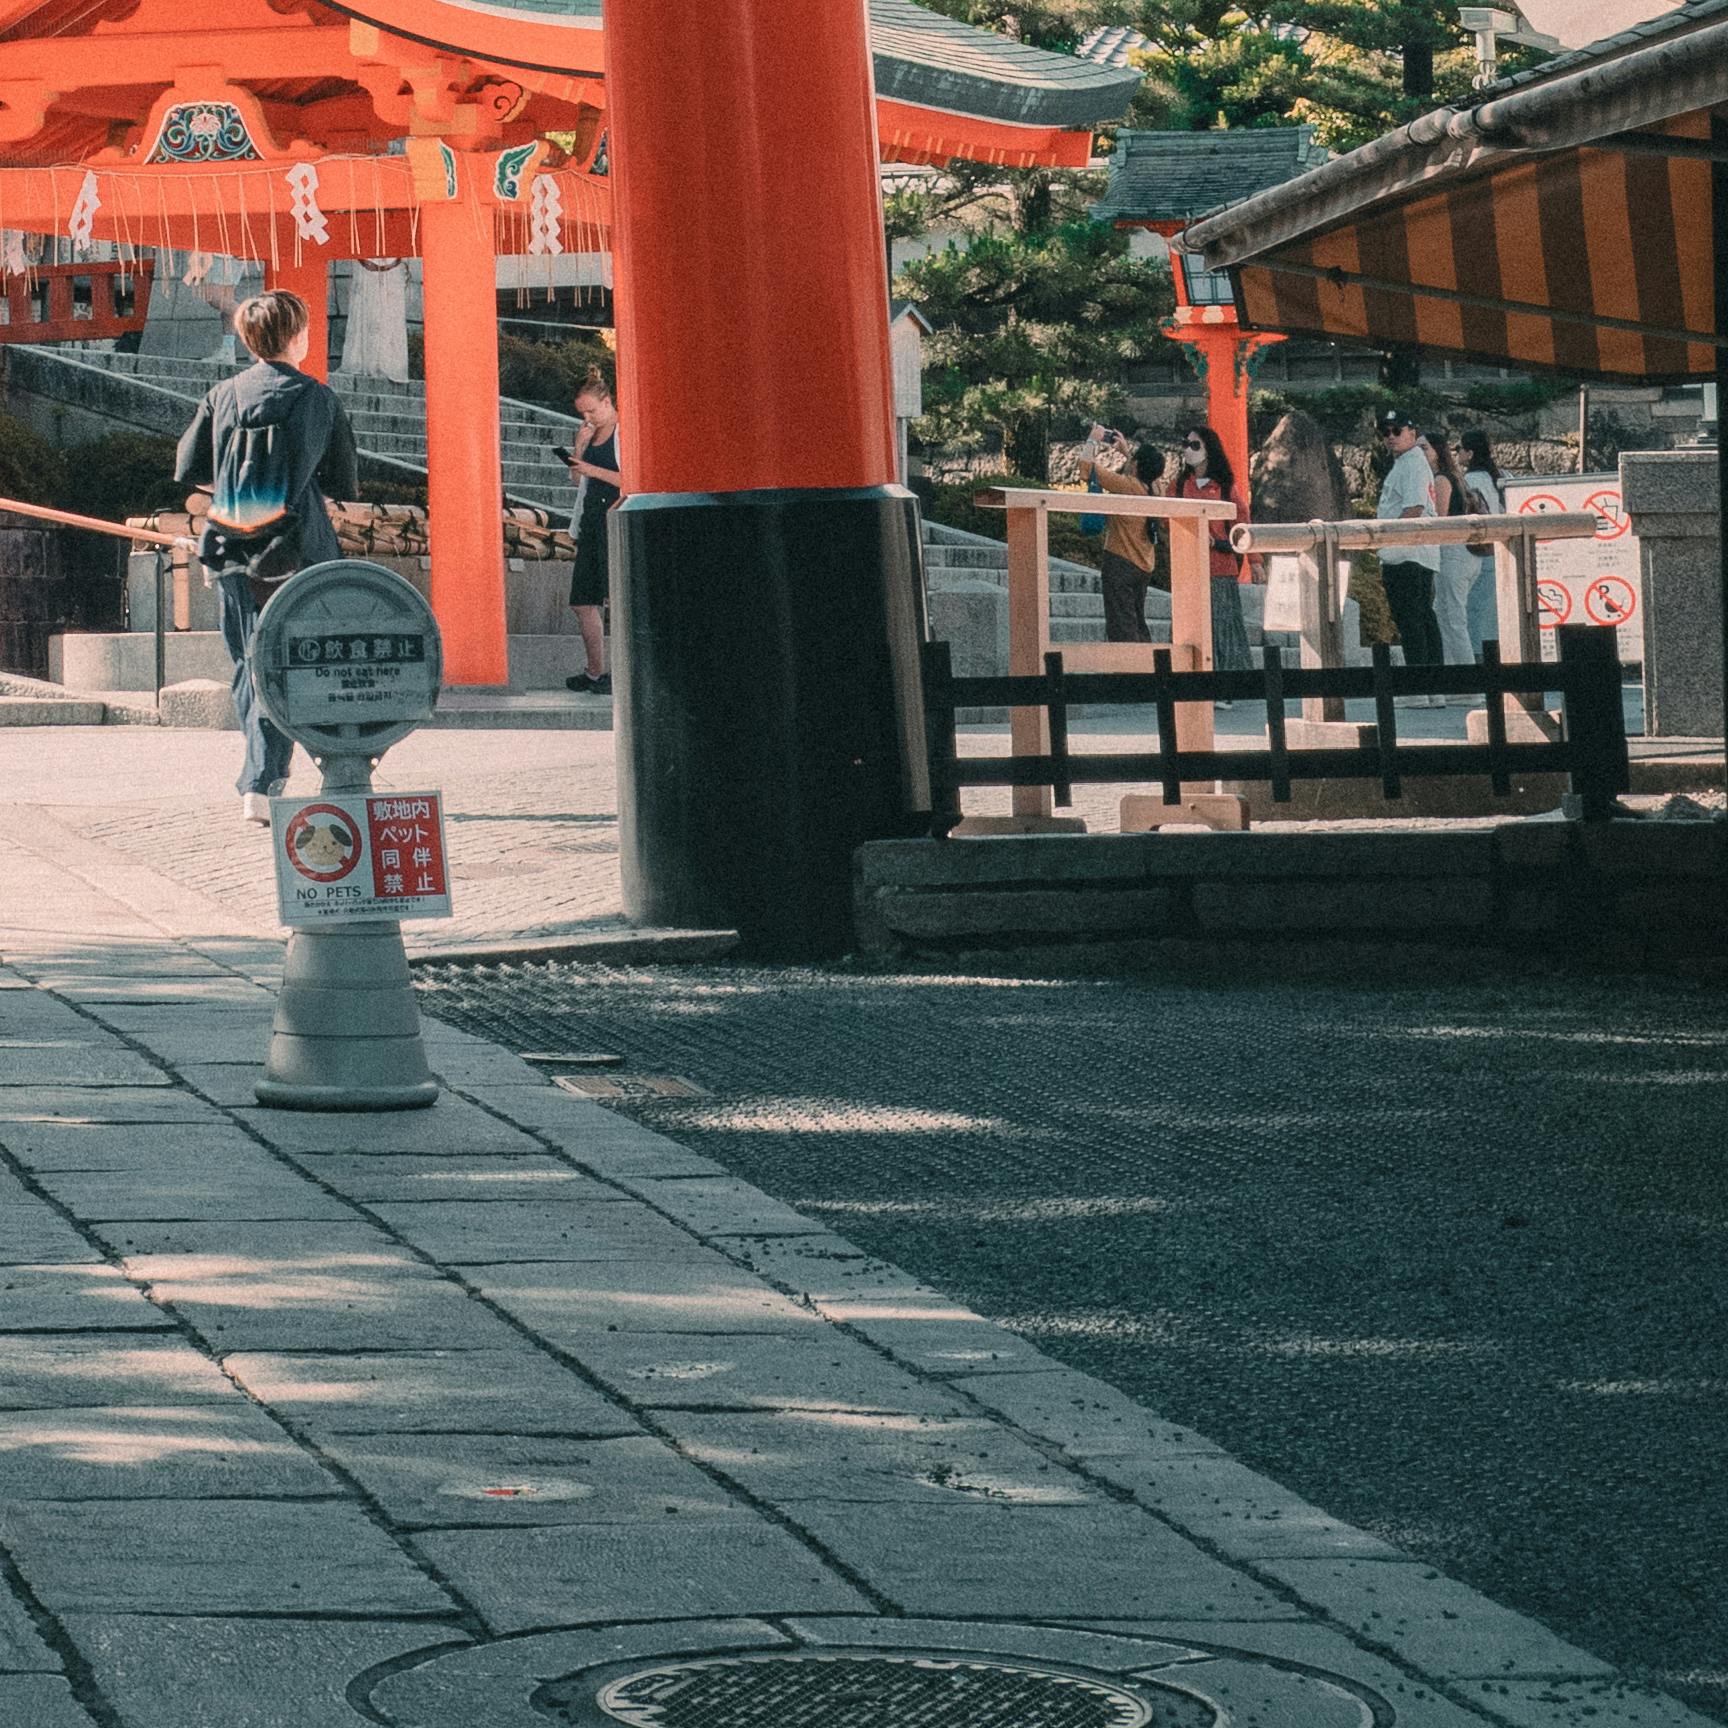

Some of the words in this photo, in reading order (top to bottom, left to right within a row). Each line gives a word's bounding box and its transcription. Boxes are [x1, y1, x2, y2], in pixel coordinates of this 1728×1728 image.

[324, 638, 416, 660] 飲食禁止
[334, 667, 353, 678] not
[374, 800, 430, 822] 敷地内
[379, 824, 429, 843] ペット
[296, 887, 318, 900] NO
[326, 885, 362, 898] PETS
